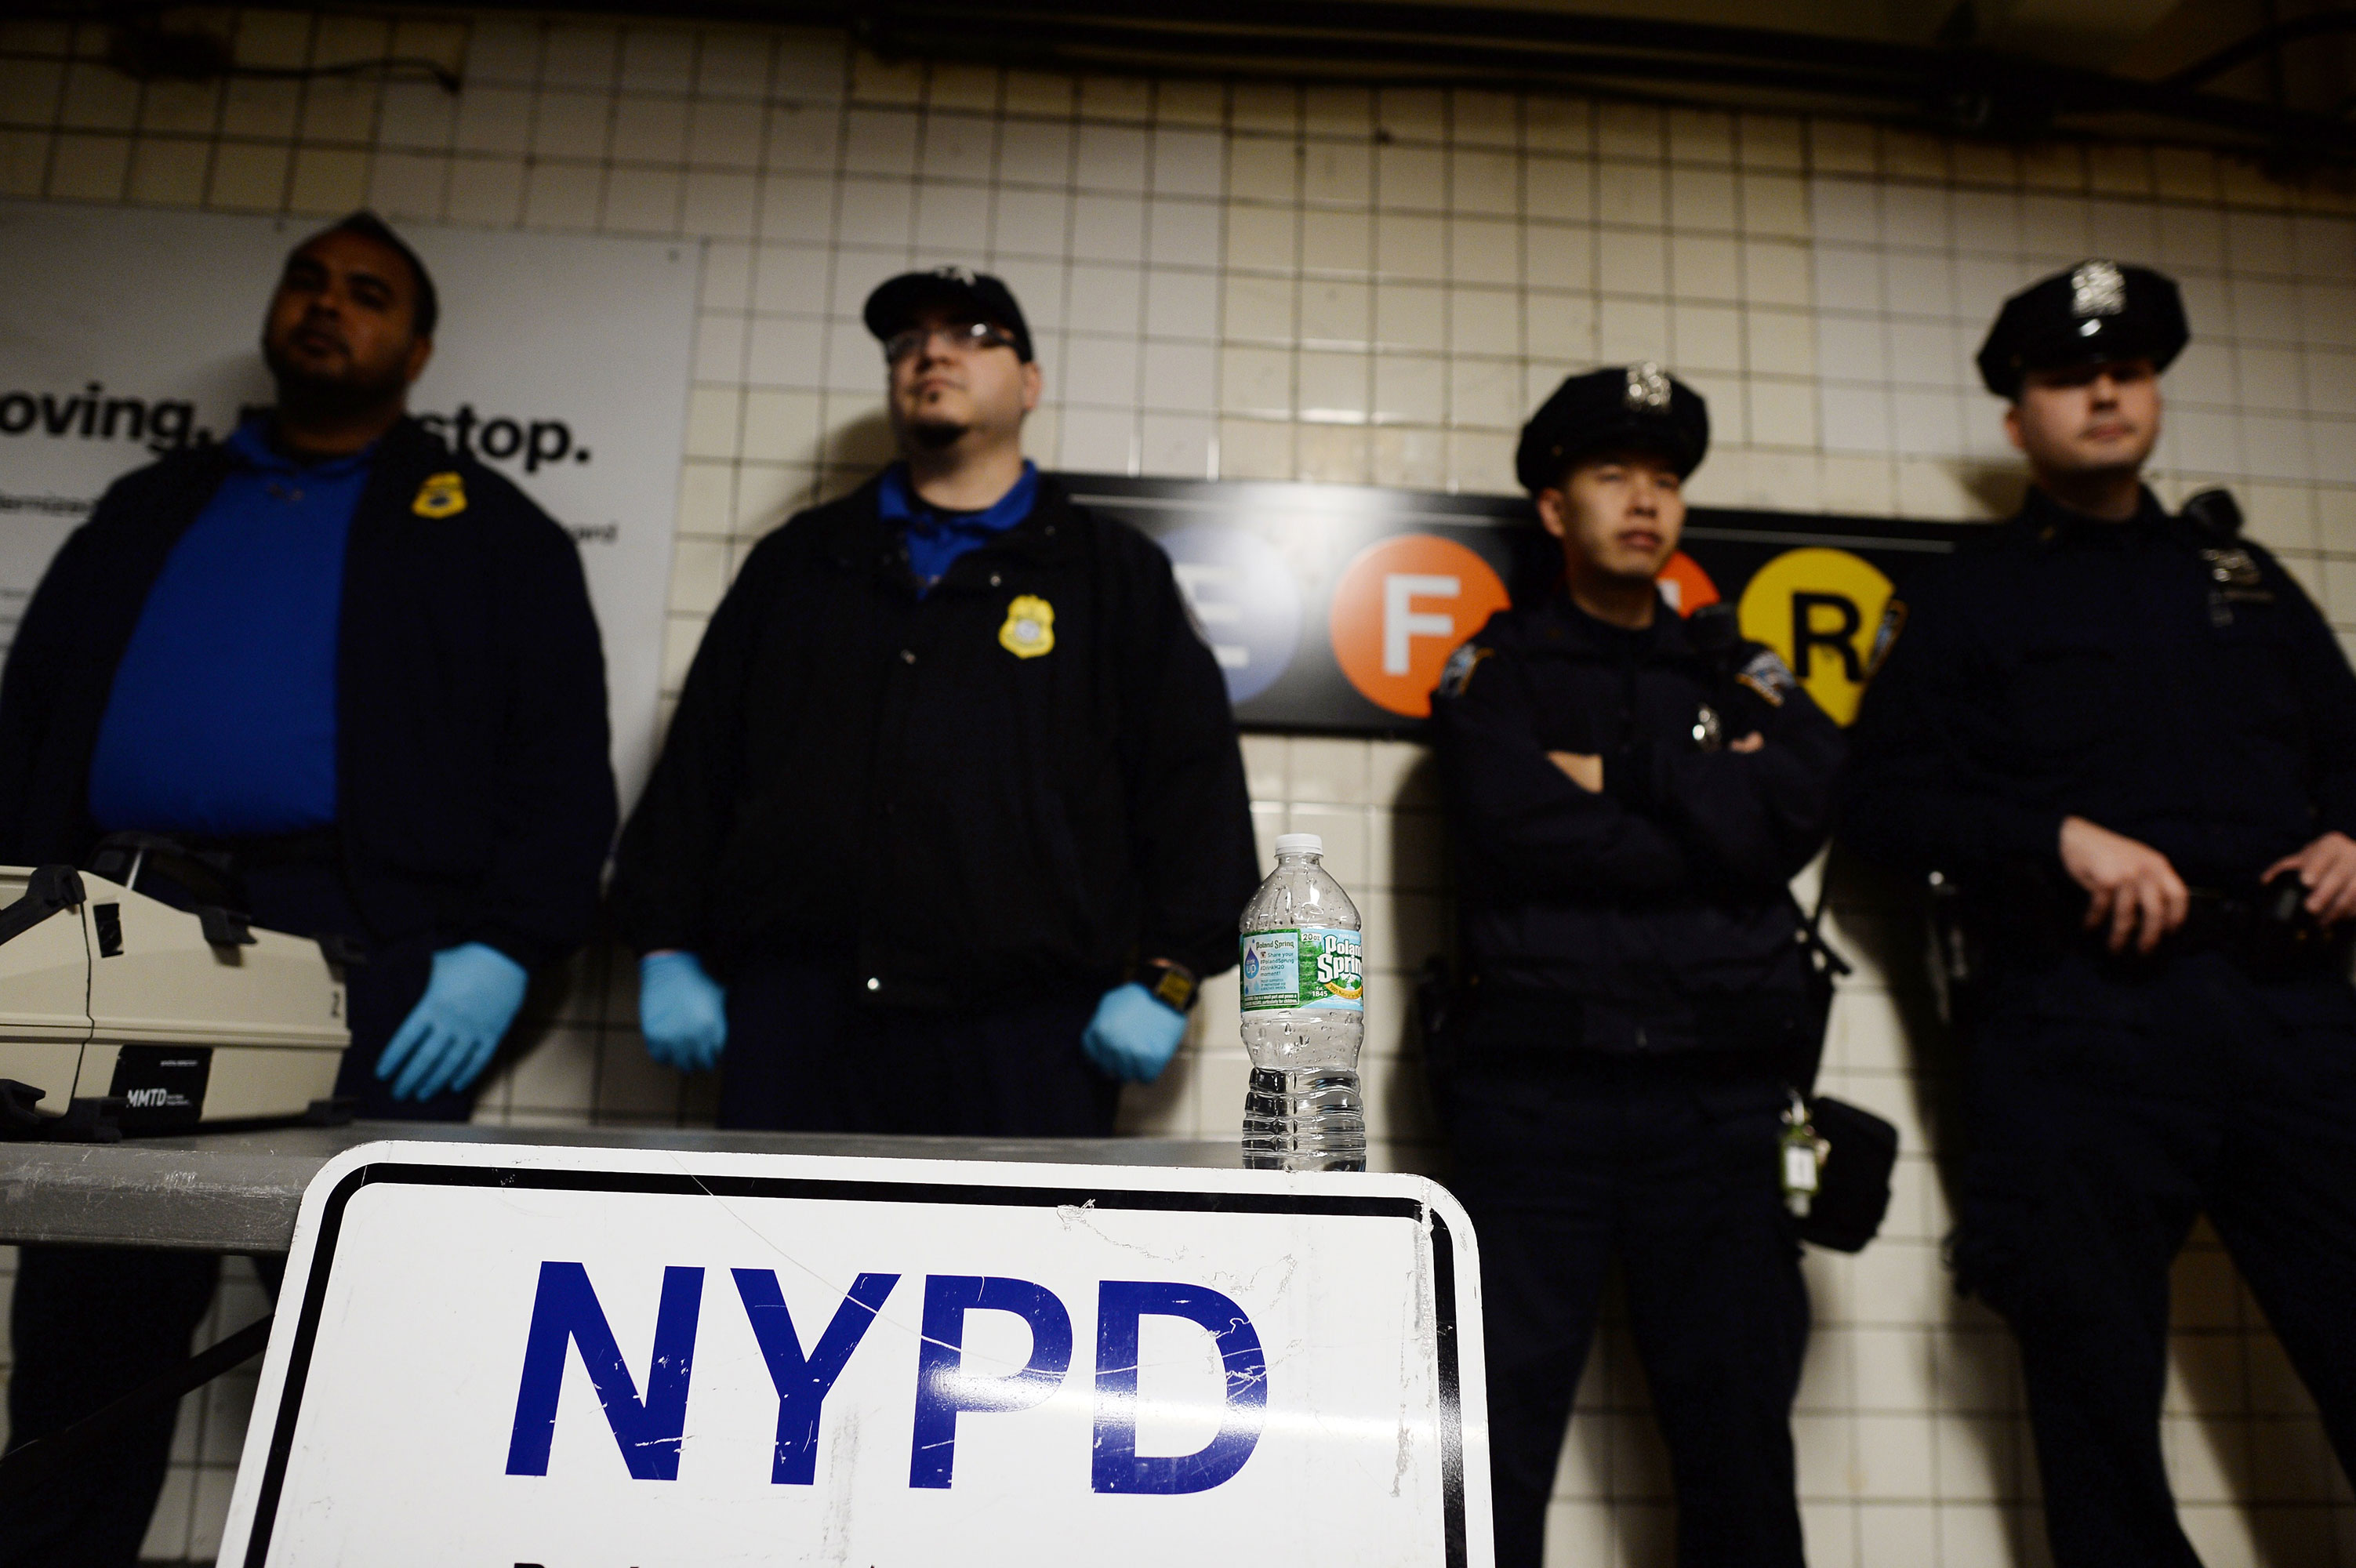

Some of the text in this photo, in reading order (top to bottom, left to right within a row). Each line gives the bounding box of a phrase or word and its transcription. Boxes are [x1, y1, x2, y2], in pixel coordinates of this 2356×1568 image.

[1385, 574, 1461, 676] F
[1792, 592, 1861, 682] R
[1256, 939, 1294, 950] Poland Spring
[127, 1088, 167, 1107] MMTD
[505, 1261, 1267, 1494] NYPD
